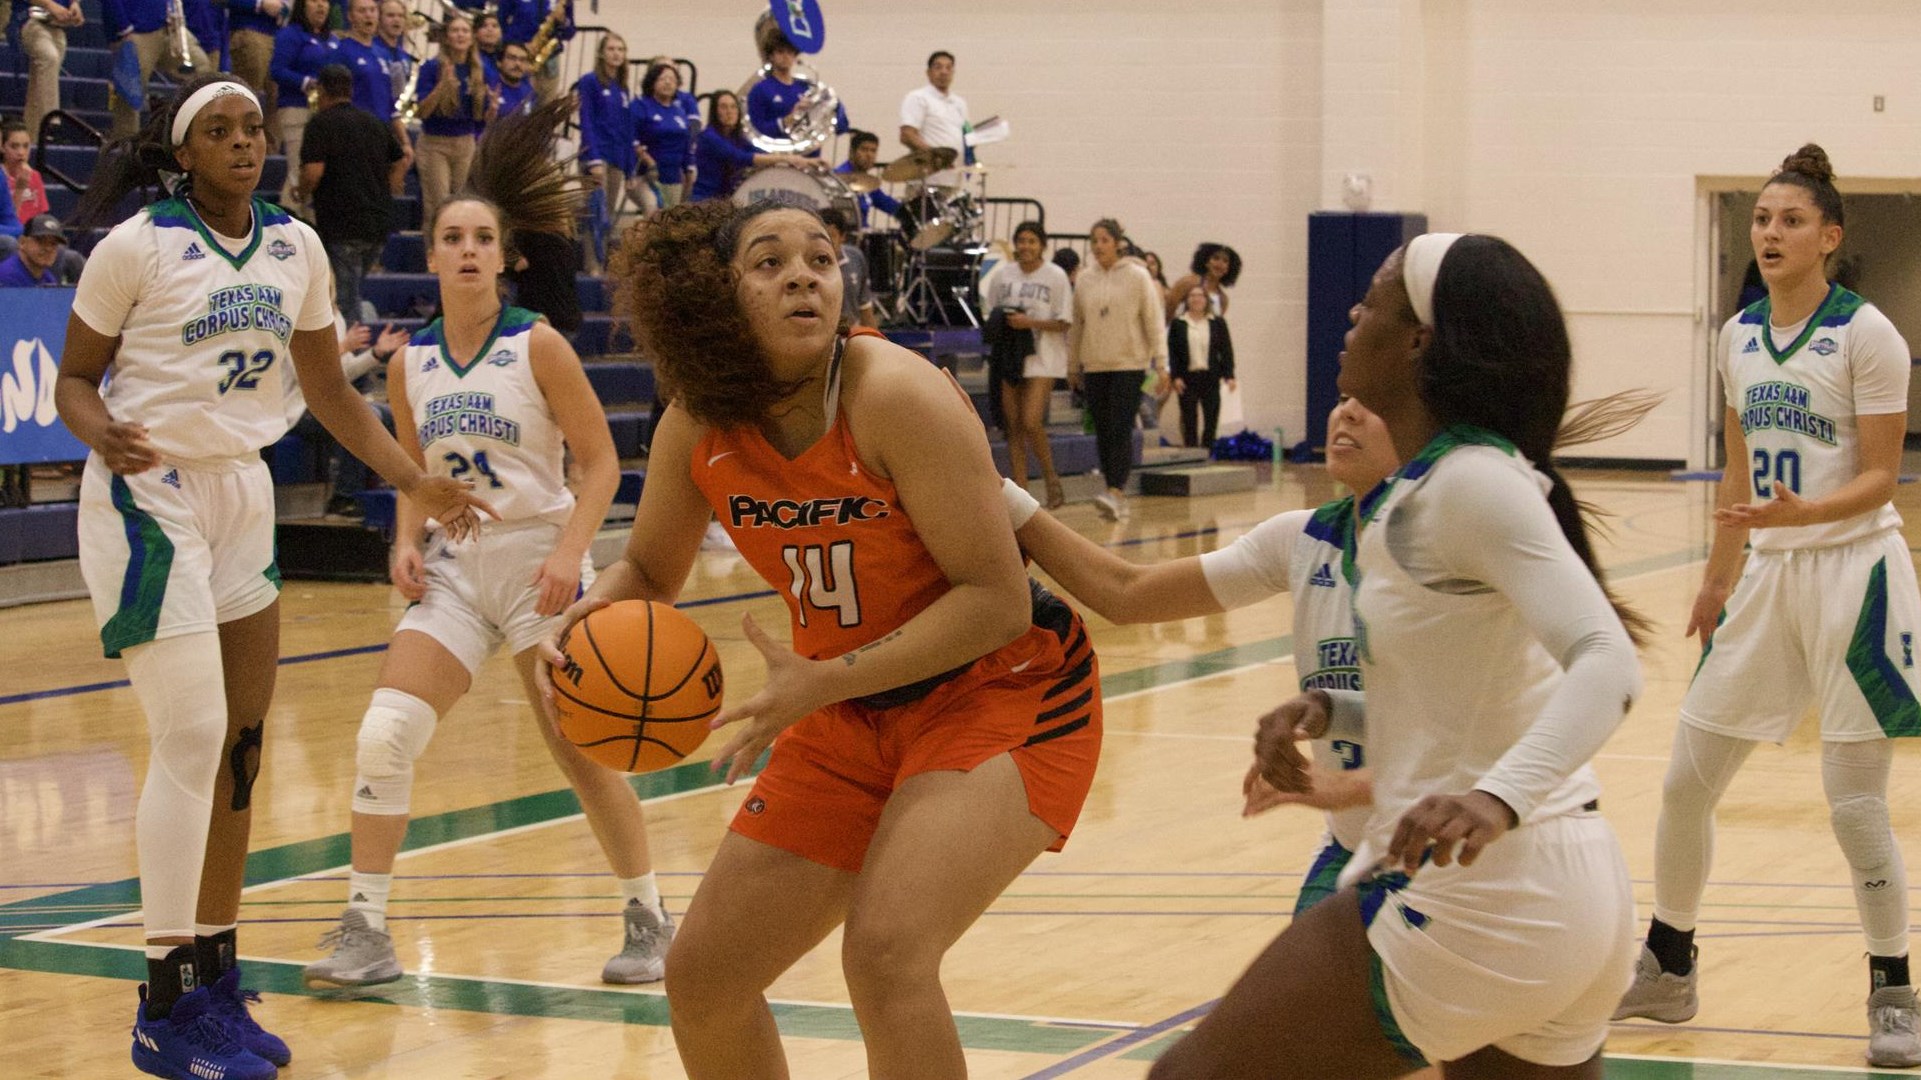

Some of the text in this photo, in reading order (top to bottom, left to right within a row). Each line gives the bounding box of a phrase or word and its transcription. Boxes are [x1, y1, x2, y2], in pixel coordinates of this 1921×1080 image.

[210, 286, 282, 311] TEXAS A&M
[184, 305, 292, 343] CORPUS CHRIST
[218, 350, 276, 395] 32
[427, 394, 492, 415] TEXAS A&M
[1746, 384, 1808, 408] TEXAS A&M
[459, 413, 518, 443] CHRISTI
[1776, 406, 1834, 442] CHRISTI
[444, 450, 503, 489] 24
[1753, 450, 1800, 497] 20
[728, 495, 891, 531] PACIFIC
[782, 540, 862, 628] 14
[1319, 640, 1359, 667] TEXA
